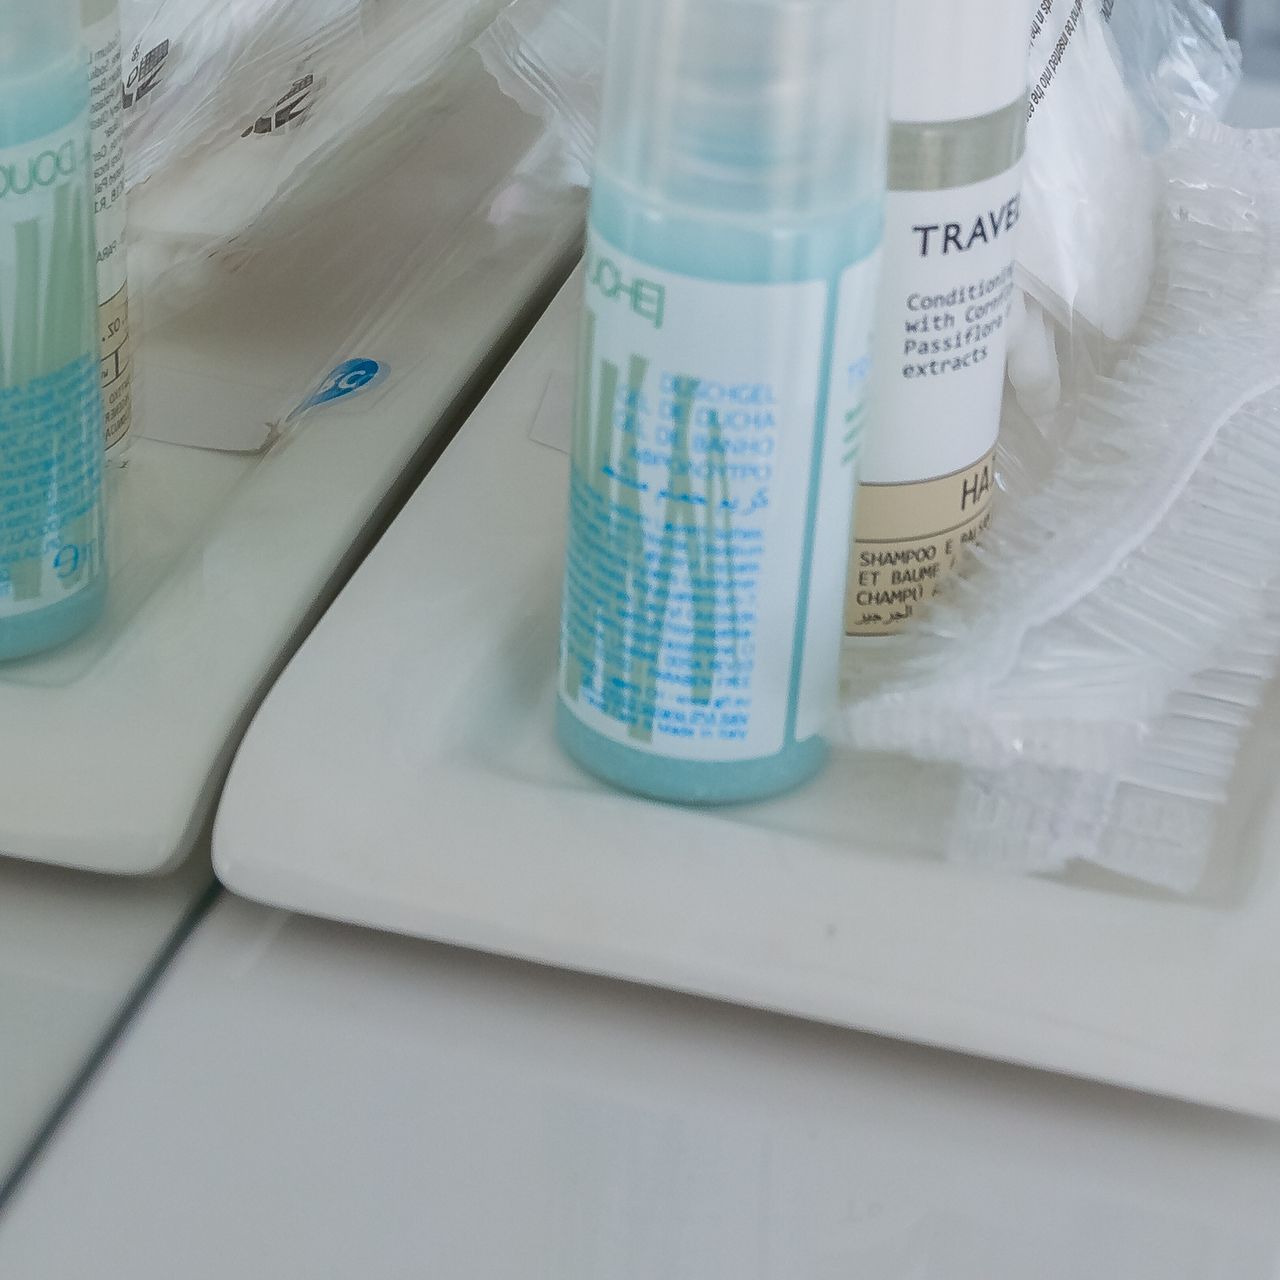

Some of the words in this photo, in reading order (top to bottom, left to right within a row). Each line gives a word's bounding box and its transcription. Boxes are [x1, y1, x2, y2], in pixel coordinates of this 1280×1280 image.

[1048, 31, 1072, 75] inserted
[1039, 66, 1055, 89] into
[1030, 84, 1046, 105] the
[905, 312, 956, 334] with
[903, 346, 988, 379] extracts
[859, 544, 937, 568] SHAMPOO
[858, 570, 881, 587] ET
